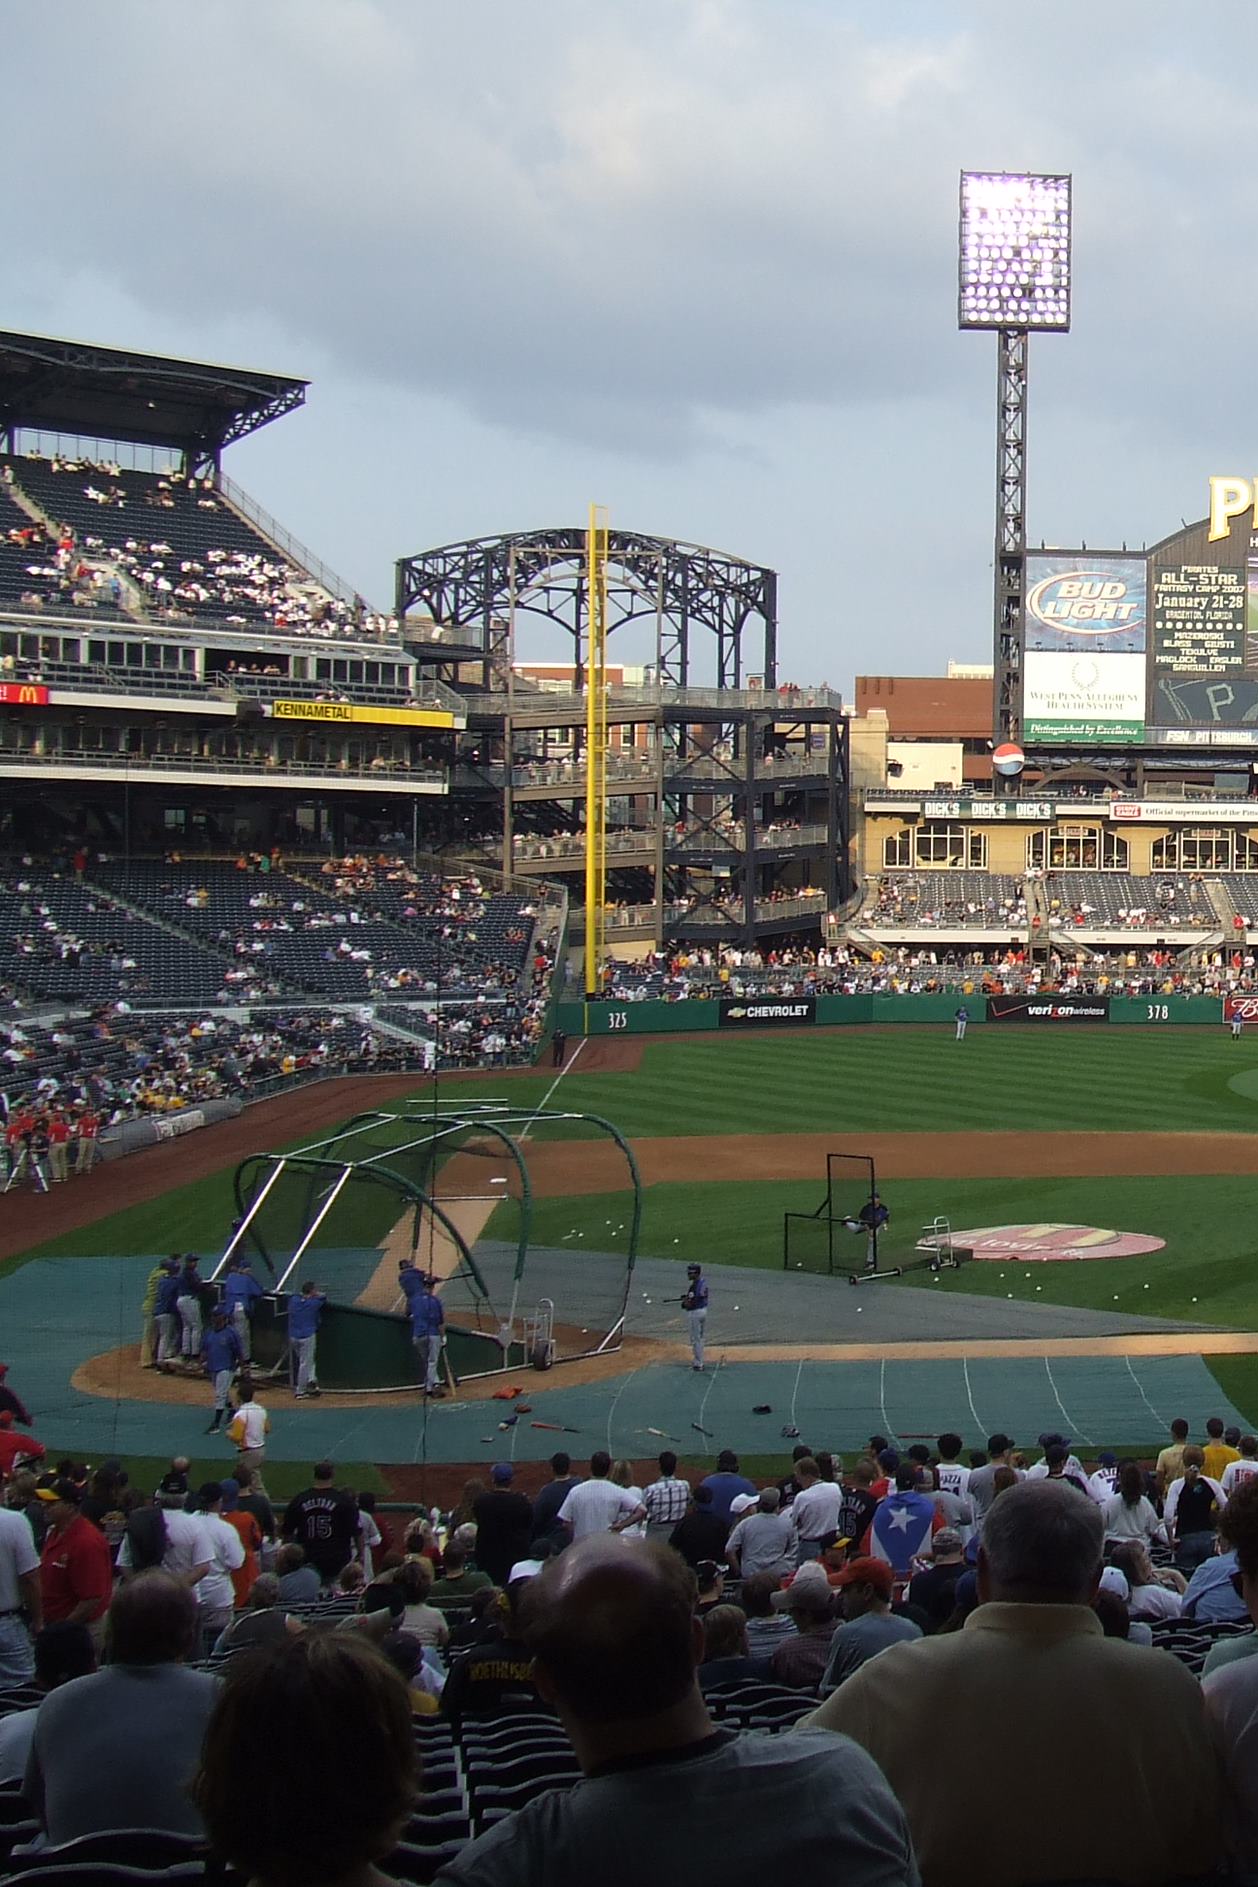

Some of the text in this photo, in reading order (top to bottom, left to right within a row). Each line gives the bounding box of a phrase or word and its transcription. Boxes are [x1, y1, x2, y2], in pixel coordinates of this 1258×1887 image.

[1161, 572, 1238, 585] ALL-STAR
[1056, 581, 1126, 600] BUD
[1154, 584, 1245, 593] FANTASY CAMP 2007
[1155, 593, 1244, 610] January 21-28
[1043, 601, 1138, 620] LIGHT
[1030, 691, 1138, 702] WEST PENN ALLEGHENY
[276, 702, 350, 719] KENNAMETAL
[1047, 701, 1123, 710] HEALTH SYSTEM
[1030, 723, 1138, 737] Distinguished by Excellence
[1166, 730, 1190, 742] FSN
[924, 802, 960, 815] DICK'S
[971, 803, 1007, 816] DICK'S
[1016, 803, 1052, 816] DICK'S
[1146, 808, 1174, 816] Official
[1175, 809, 1219, 818] supermarket
[1229, 808, 1240, 816] the
[747, 1005, 808, 1018] CHEVROLET
[1028, 1003, 1105, 1018] verizon wireless
[1147, 1005, 1168, 1020] 378
[608, 1012, 627, 1029] 325
[306, 1515, 333, 1539] 15
